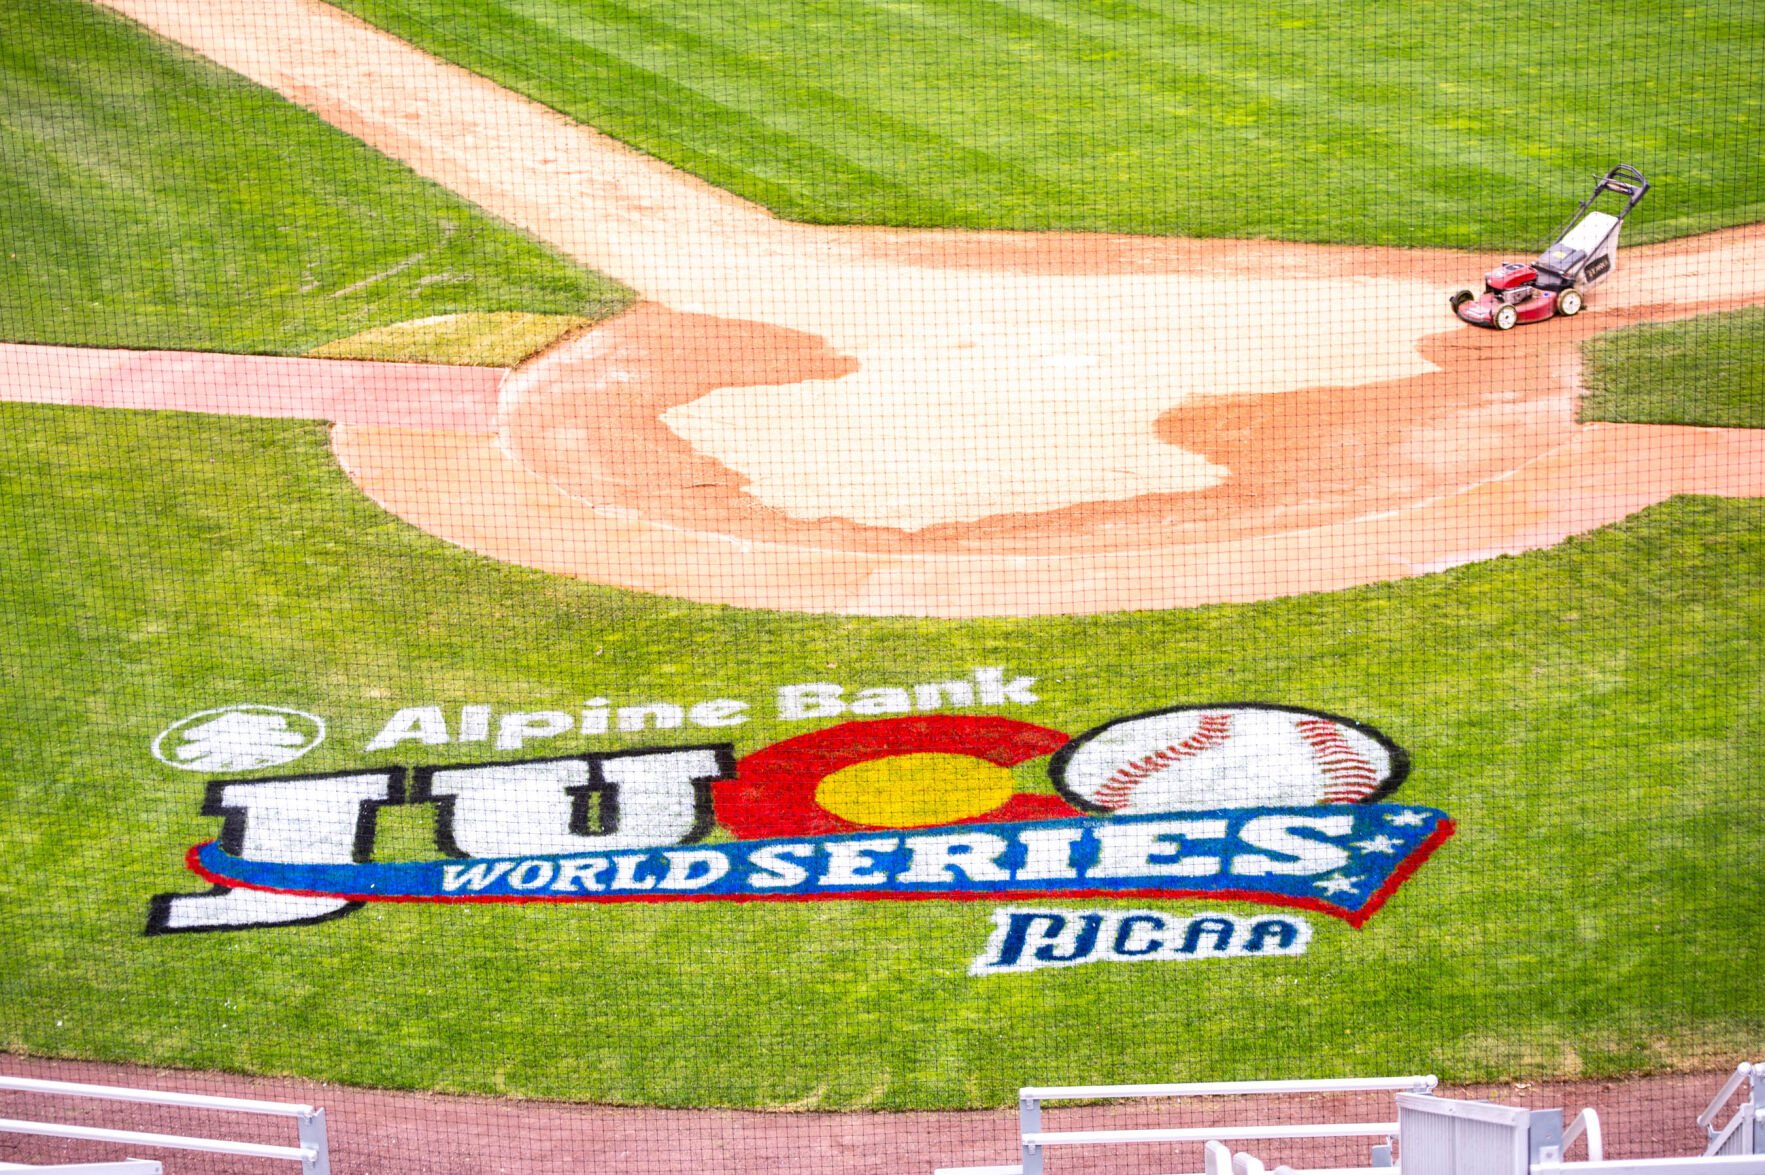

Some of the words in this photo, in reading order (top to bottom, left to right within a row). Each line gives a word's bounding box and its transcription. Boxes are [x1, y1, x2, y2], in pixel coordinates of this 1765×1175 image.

[365, 698, 749, 751] Alpine
[777, 666, 1038, 722] Bank
[442, 849, 730, 894] WORLD
[747, 815, 1355, 889] SERIES
